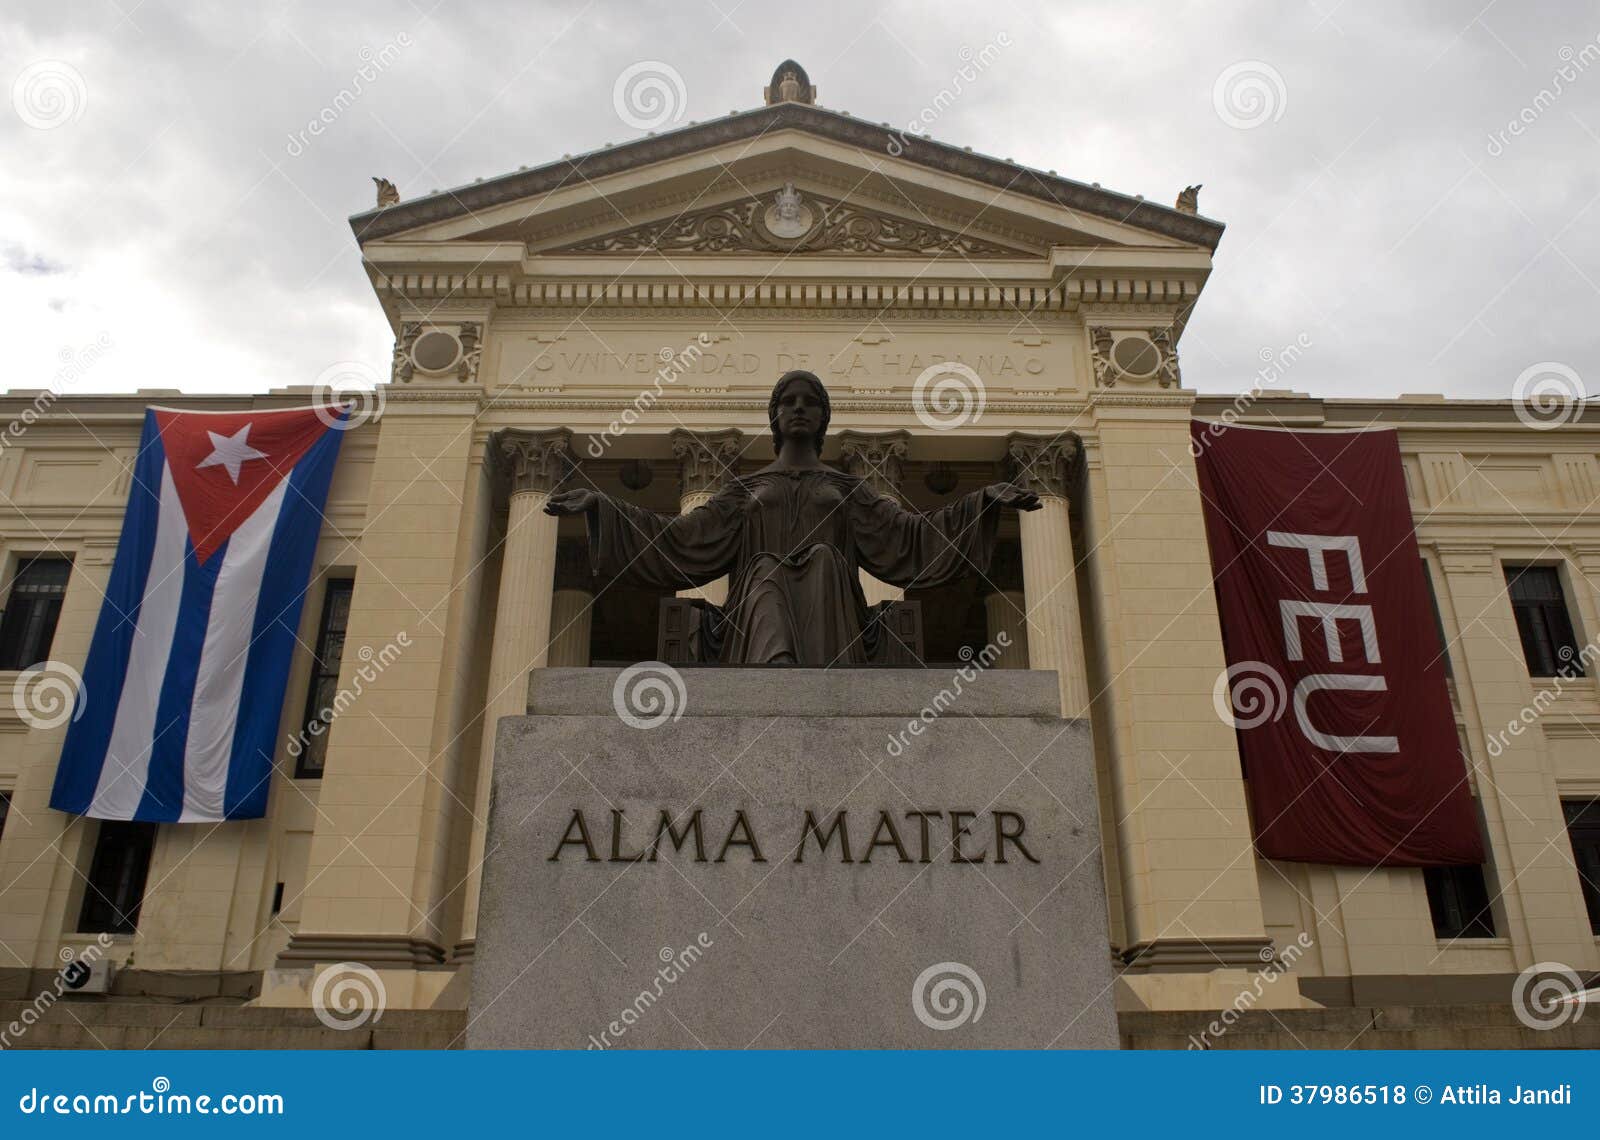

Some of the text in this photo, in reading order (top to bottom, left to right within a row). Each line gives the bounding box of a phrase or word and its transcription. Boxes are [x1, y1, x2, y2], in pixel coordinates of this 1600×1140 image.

[1266, 530, 1400, 753] FEU
[547, 809, 1040, 864] ALMA MATER
